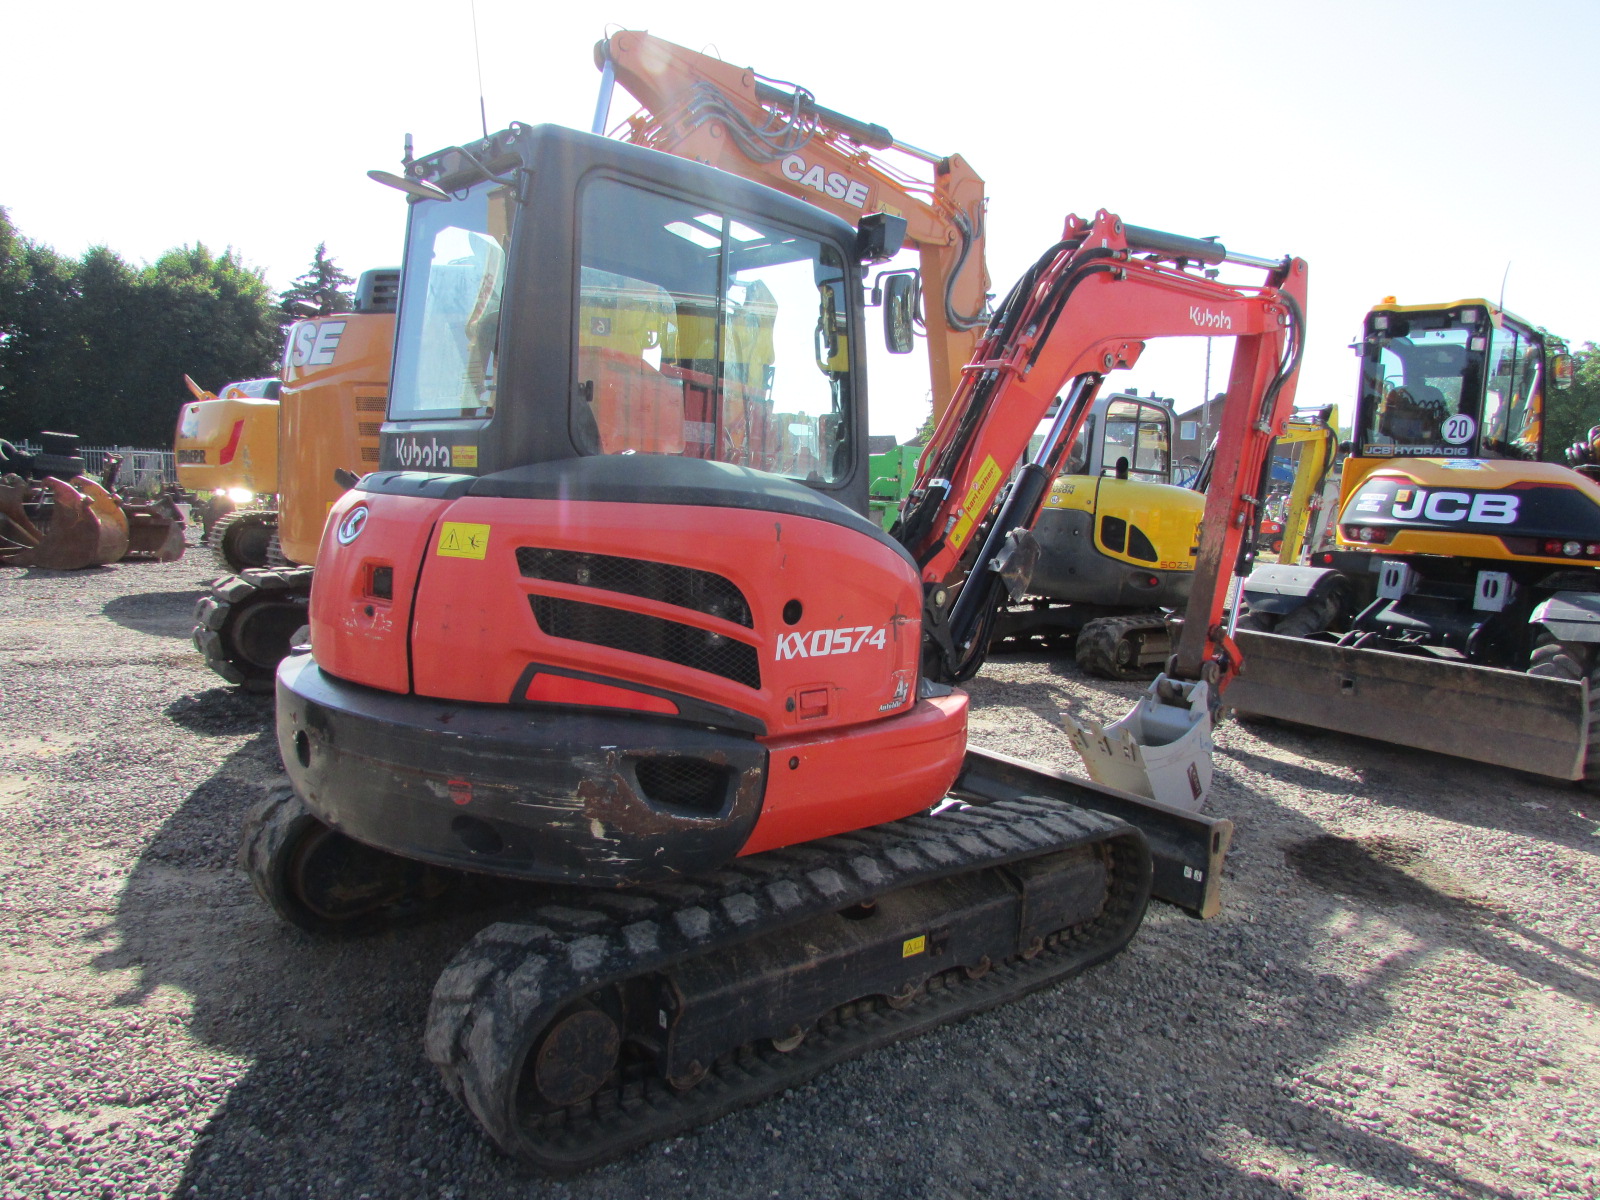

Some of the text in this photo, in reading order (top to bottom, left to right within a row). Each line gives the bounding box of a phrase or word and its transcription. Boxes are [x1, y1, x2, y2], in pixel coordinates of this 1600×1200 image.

[781, 154, 870, 208] CASE
[1189, 305, 1231, 329] Kubota
[1449, 419, 1467, 438] 20
[396, 437, 450, 467] Kubota
[1365, 446, 1468, 456] JCB HYDRADIG
[1391, 489, 1520, 524] JCB
